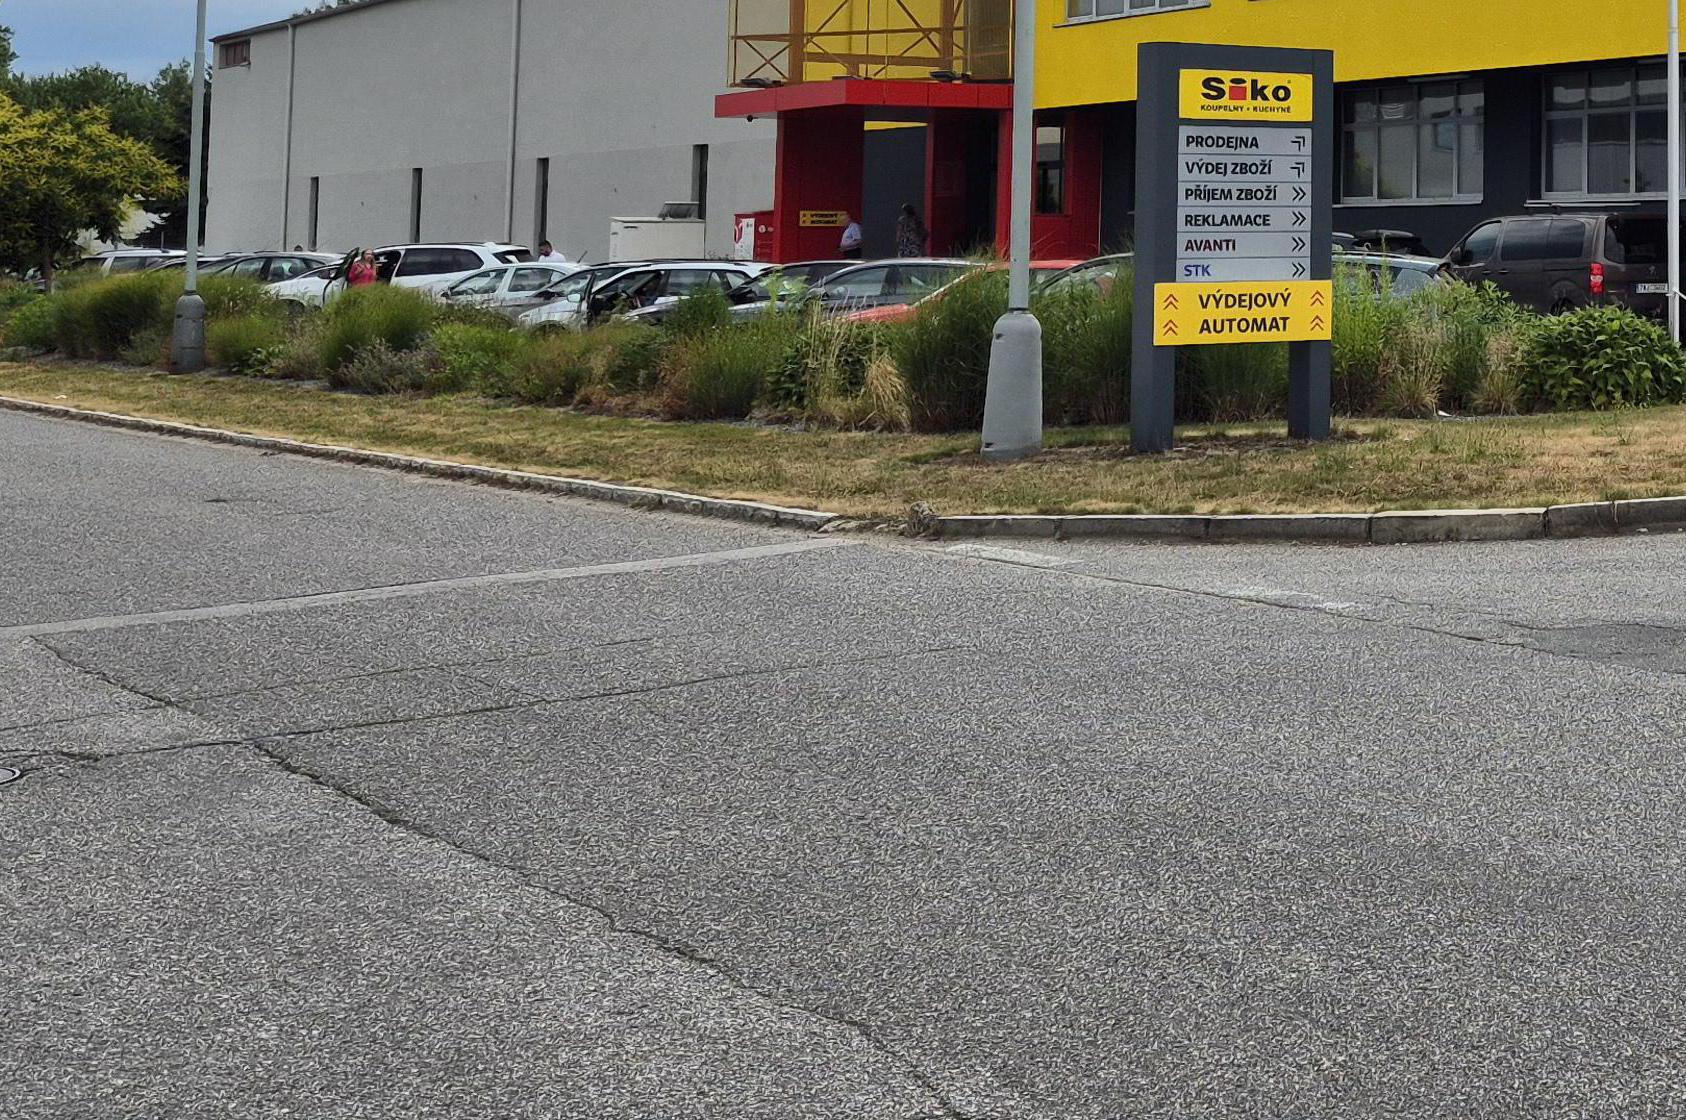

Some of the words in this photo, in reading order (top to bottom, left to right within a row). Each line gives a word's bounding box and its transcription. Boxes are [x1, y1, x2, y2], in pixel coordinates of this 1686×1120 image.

[1201, 76, 1291, 102] Siko
[1185, 135, 1259, 151] PRODEJNA
[1185, 158, 1228, 177] VÝDEJ
[1230, 159, 1273, 175] ZBOŽÍ
[1184, 184, 1233, 203] PŘÍJEM
[1236, 184, 1278, 201] ZBOŽÍ
[1184, 214, 1271, 227] REKLAMACE
[1184, 239, 1236, 252] AVANTI
[1184, 264, 1211, 277] STK
[1198, 288, 1292, 311] VÝDEJOVÝ
[1199, 317, 1290, 334] AUTOMAT
